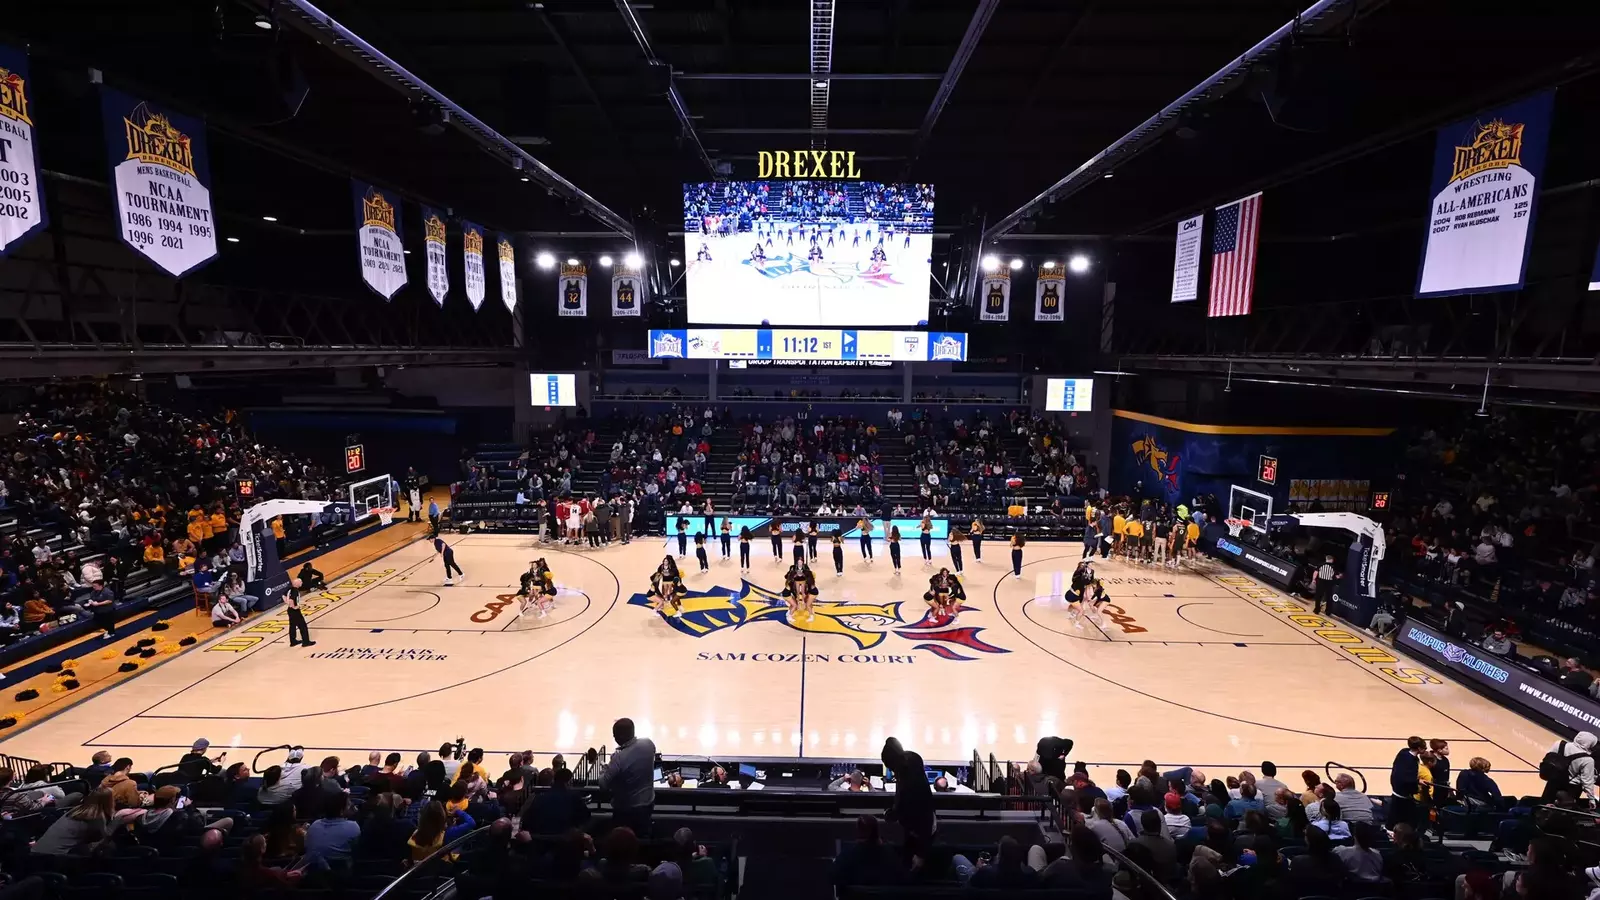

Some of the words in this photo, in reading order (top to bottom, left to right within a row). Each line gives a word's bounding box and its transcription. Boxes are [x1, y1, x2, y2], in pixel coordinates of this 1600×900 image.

[129, 125, 191, 168] DREXEL
[758, 150, 860, 178] DREXEL
[1454, 138, 1520, 177] DREXEL
[0, 169, 29, 186] 003
[137, 166, 154, 175] MENS
[155, 167, 192, 188] BASKETBALL
[1454, 172, 1512, 194] WRESTLING
[148, 180, 184, 202] NCAA
[1436, 183, 1528, 215] ALL-AMERICANS
[126, 192, 209, 222] TOURNAMENT
[1433, 217, 1451, 226] 2004
[1454, 213, 1466, 222] ROB
[1514, 201, 1528, 210] 125
[127, 212, 152, 228] 1986
[158, 218, 183, 233] 1994
[189, 224, 211, 239] 1995
[1183, 219, 1197, 231] CAA
[1432, 225, 1450, 234] 2007
[1453, 222, 1468, 230] RYAN
[1513, 210, 1527, 219] 157
[128, 229, 154, 245] 1996
[161, 235, 184, 249] 2021
[373, 236, 390, 250] NCAA
[363, 246, 401, 263] TOURNAMENT
[567, 292, 579, 303] 32
[619, 292, 632, 303] 44
[991, 296, 1001, 307] 10
[1044, 296, 1057, 308] 00
[783, 337, 818, 353] 11:12
[348, 455, 360, 469] 20
[1262, 466, 1274, 480] 20
[240, 486, 251, 495] 20
[1375, 500, 1386, 508] 20
[469, 593, 520, 623] CAA
[1215, 575, 1444, 685] DRAGONS
[305, 652, 381, 660] ATHLETIC
[696, 651, 746, 661] SAM
[751, 652, 830, 663] COZEN
[837, 653, 917, 664] COURT
[1407, 627, 1447, 653] KAMPUS
[1462, 653, 1509, 684] KLOTHES
[1519, 682, 1600, 729] WWW.KAMPUSKLOTH
